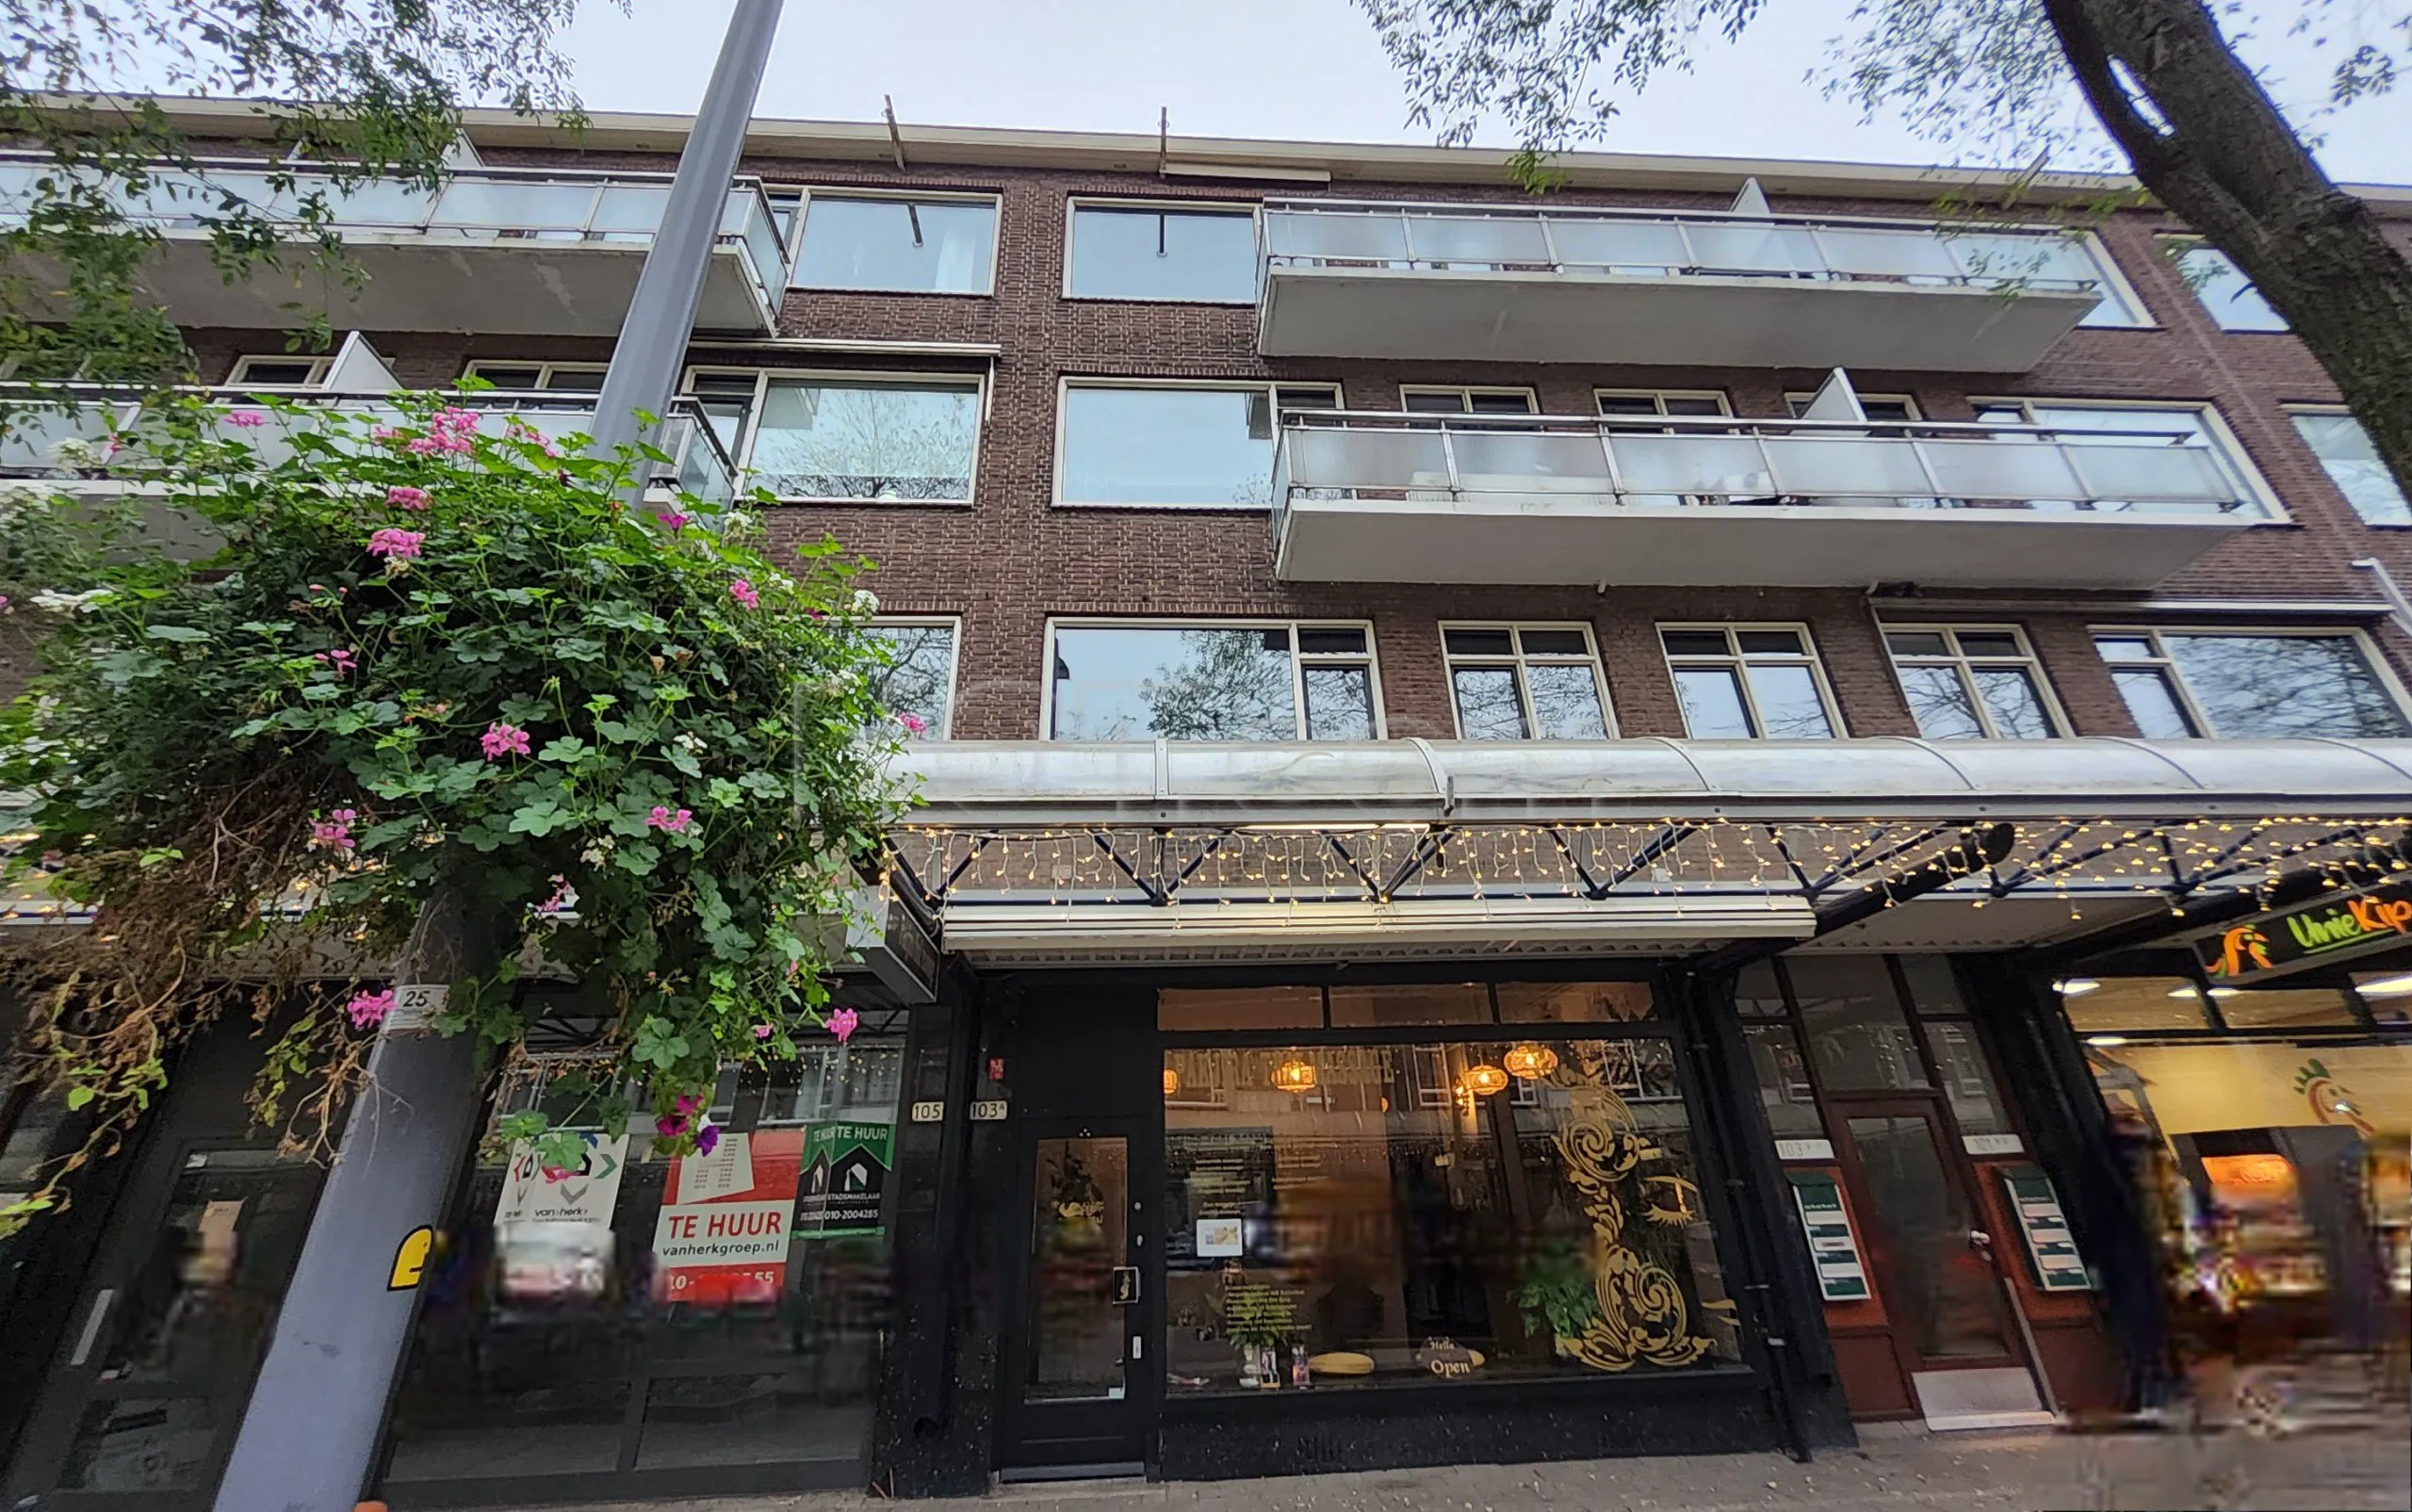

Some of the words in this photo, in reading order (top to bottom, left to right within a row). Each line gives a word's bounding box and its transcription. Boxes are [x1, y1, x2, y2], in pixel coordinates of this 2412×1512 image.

[2287, 896, 2412, 948] UnieKip
[402, 990, 431, 1007] 25
[915, 1103, 941, 1119] 105
[972, 1102, 1005, 1118] 103A
[837, 1126, 852, 1139] TE
[854, 1127, 888, 1141] HUUR
[534, 1208, 556, 1217] van
[668, 1215, 699, 1240] TE
[707, 1211, 782, 1238] HUUR
[662, 1240, 780, 1257] vanherkgroep.nl
[1430, 1359, 1471, 1378] Open
